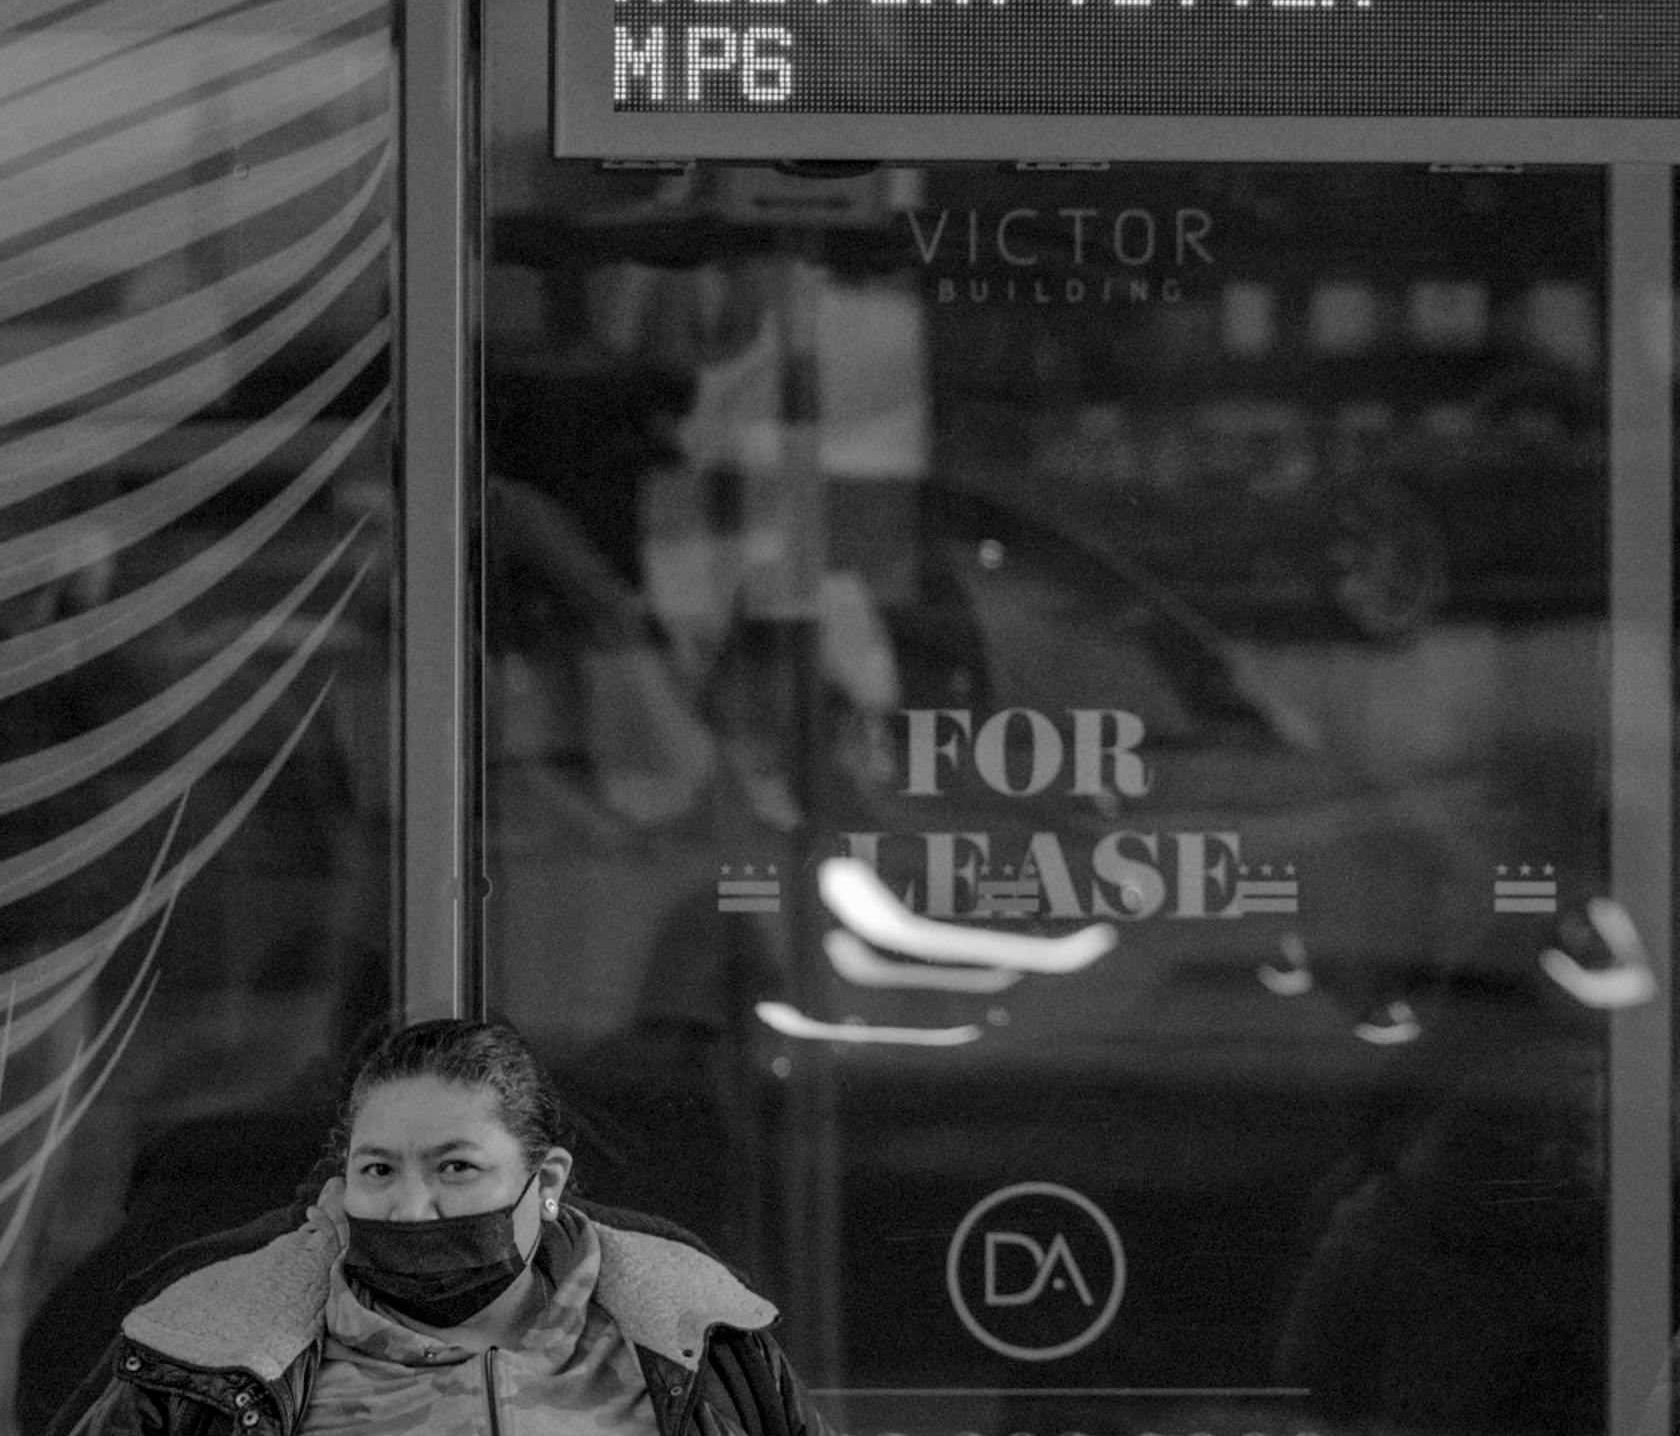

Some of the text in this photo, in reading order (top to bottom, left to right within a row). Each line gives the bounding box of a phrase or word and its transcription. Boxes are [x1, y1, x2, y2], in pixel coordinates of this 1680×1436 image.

[613, 25, 665, 101] M
[686, 26, 793, 102] P6
[906, 206, 1216, 266] VICTOR
[936, 277, 1184, 304] BUILDING
[896, 707, 1156, 798] FOR
